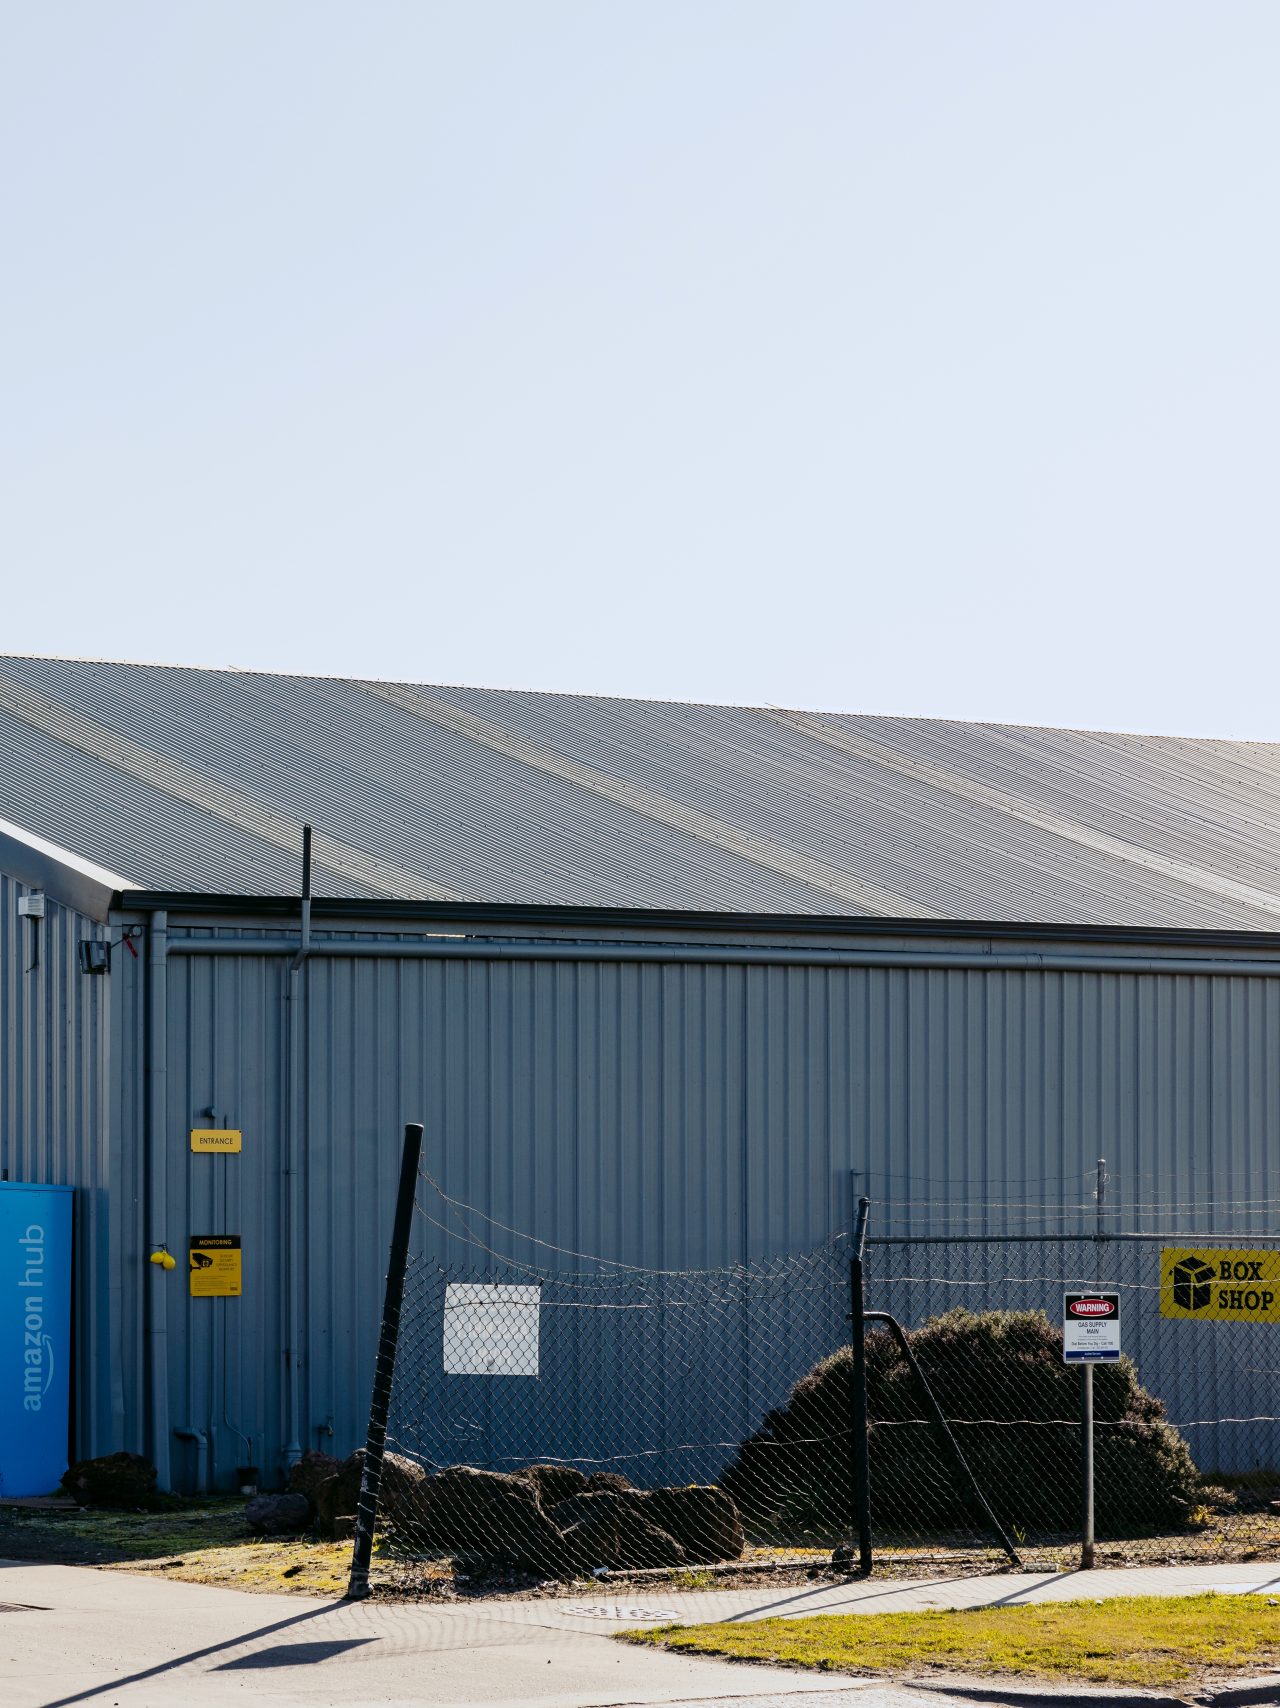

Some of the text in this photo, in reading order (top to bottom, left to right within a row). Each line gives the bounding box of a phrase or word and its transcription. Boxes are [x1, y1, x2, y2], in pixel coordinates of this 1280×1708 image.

[199, 1137, 233, 1145] ENTRANCE
[1219, 1260, 1264, 1281] BOX
[1075, 1303, 1109, 1312] WARNING
[1218, 1289, 1274, 1311] SHOP
[18, 1224, 45, 1412] amazon hub
